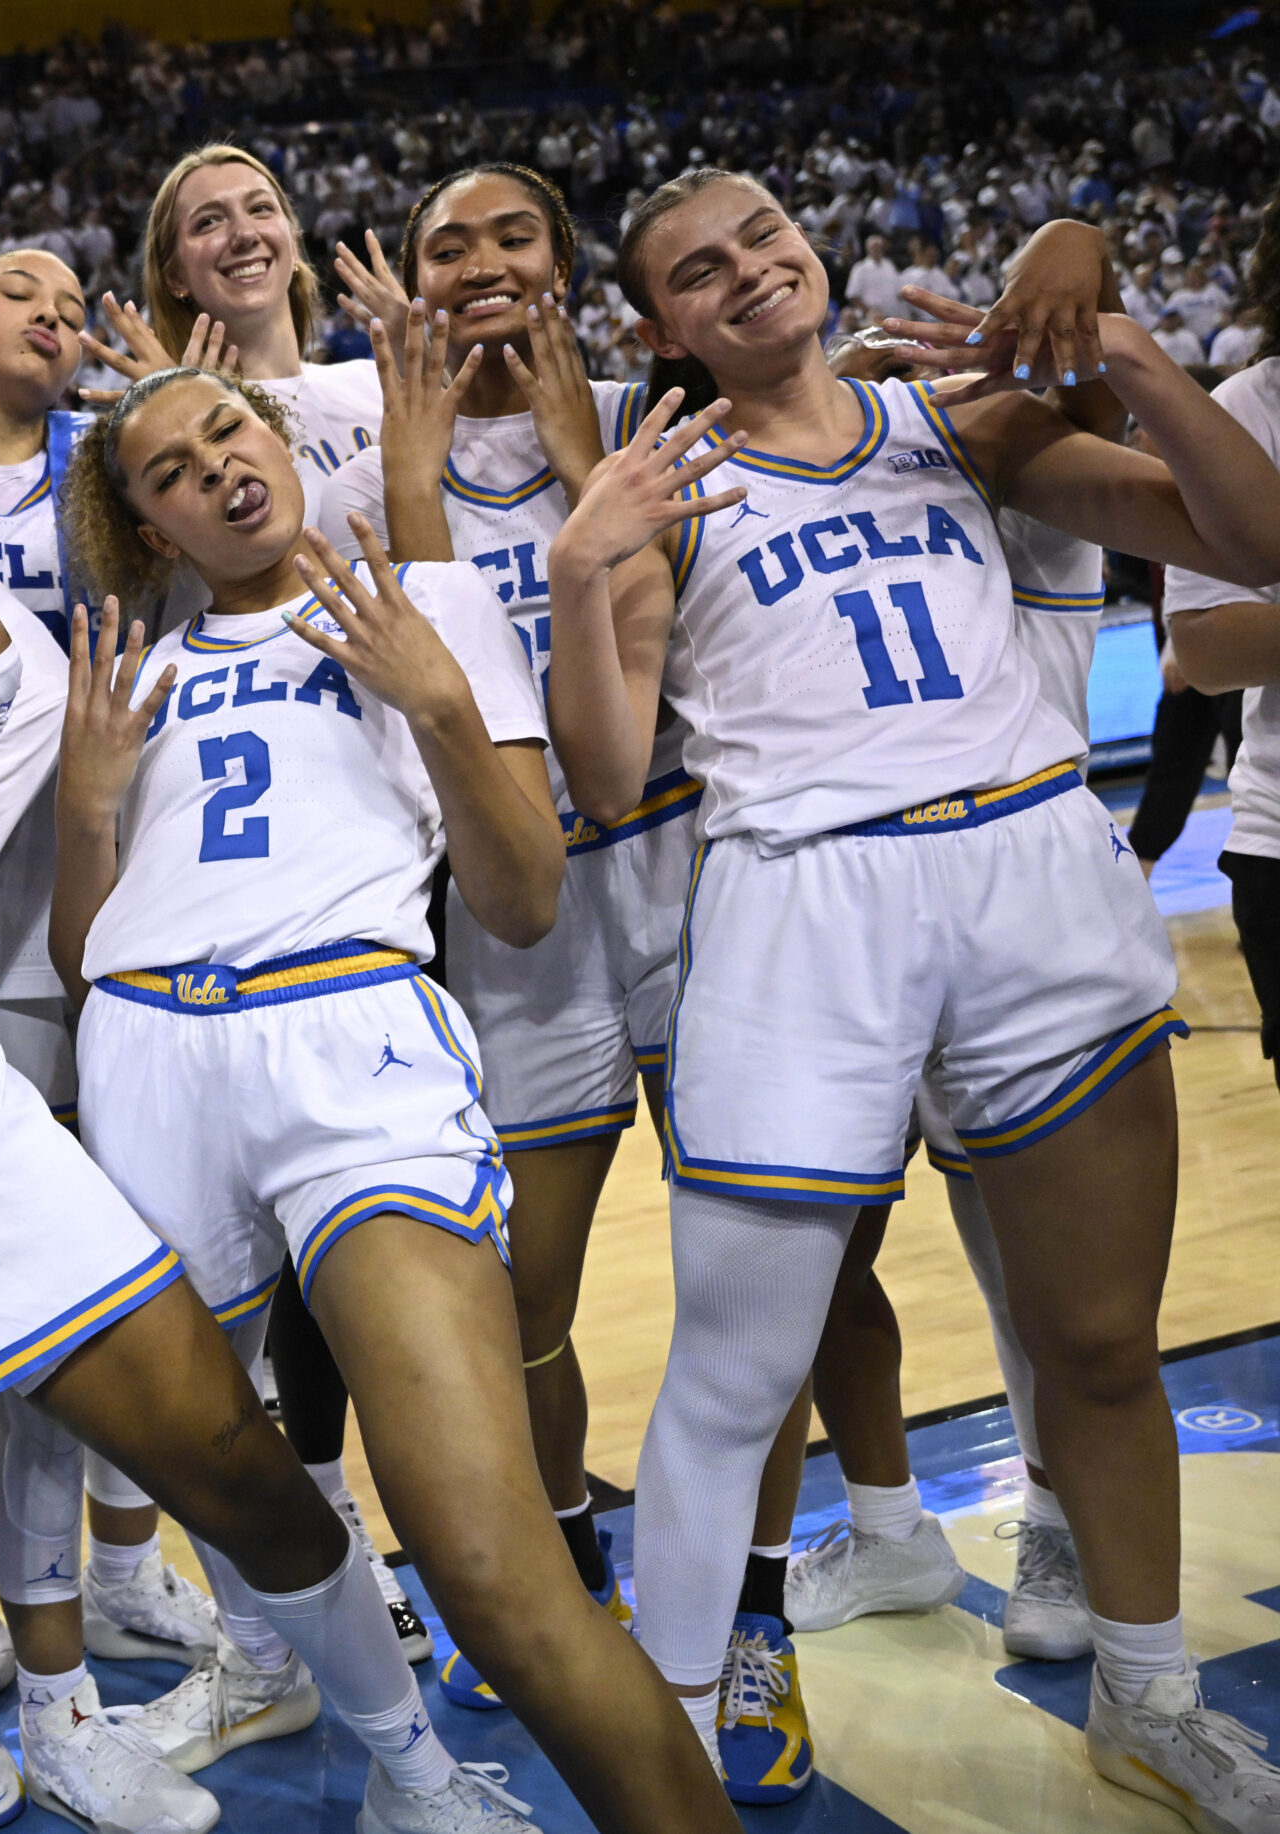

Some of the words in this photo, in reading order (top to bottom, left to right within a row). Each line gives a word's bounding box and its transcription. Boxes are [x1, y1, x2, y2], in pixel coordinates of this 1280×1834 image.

[471, 541, 550, 604] CL
[737, 504, 984, 606] UCLA
[833, 581, 965, 709] 11
[199, 730, 272, 864] 2
[564, 816, 601, 847] cla
[176, 972, 230, 1006] Ucla
